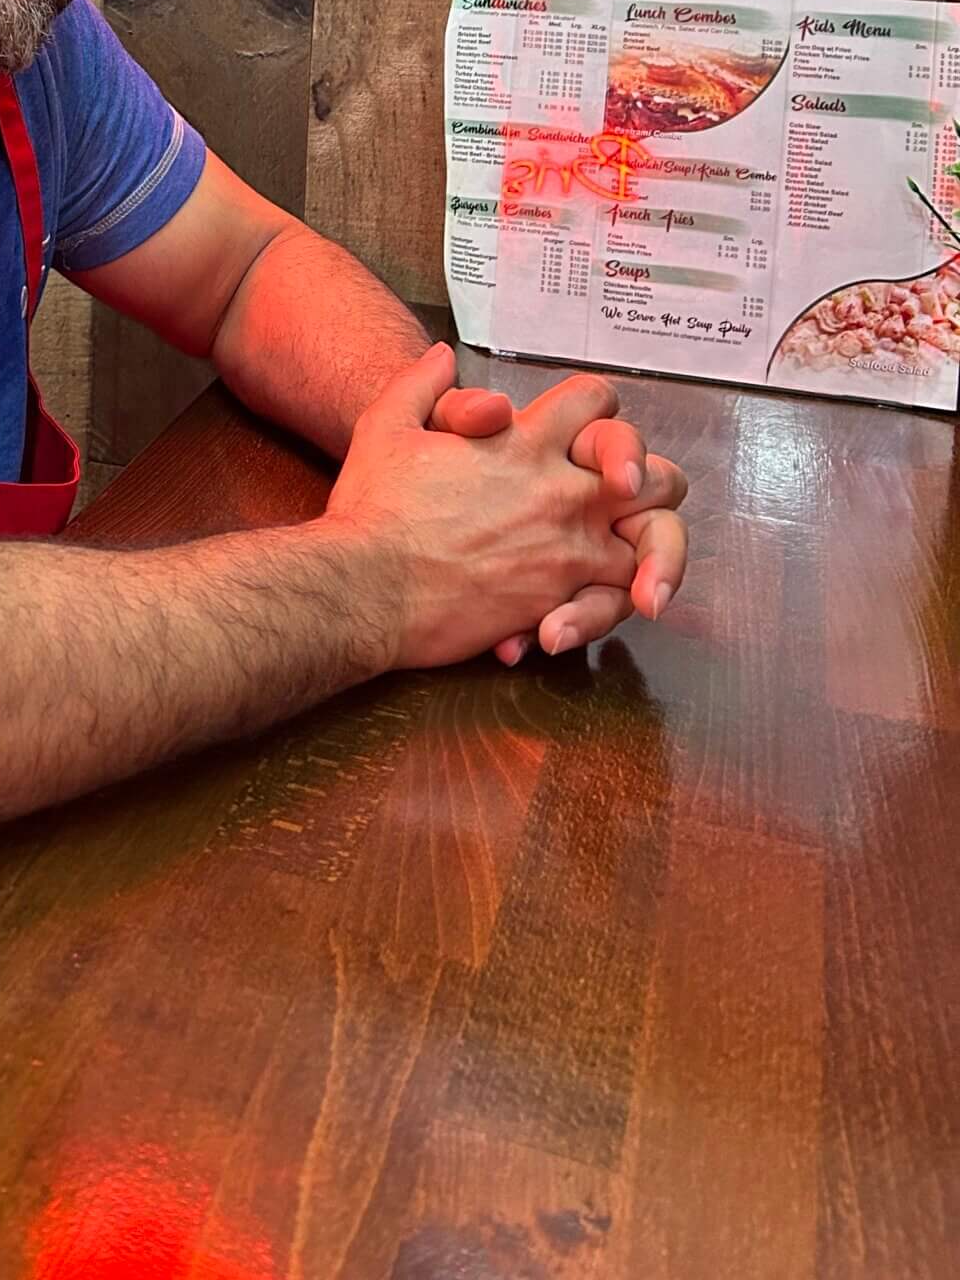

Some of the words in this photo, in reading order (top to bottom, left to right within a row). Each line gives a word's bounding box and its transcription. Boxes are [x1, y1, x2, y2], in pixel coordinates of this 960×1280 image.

[625, 3, 666, 22] Lunch
[674, 8, 737, 24] Combos
[796, 16, 835, 42] Kids
[842, 19, 891, 38] Menu
[791, 94, 846, 113] Salads
[451, 196, 489, 215] Burgers
[504, 202, 552, 219] Combos
[605, 259, 651, 282] Soups
[601, 306, 623, 319] We
[687, 317, 713, 332] Soup
